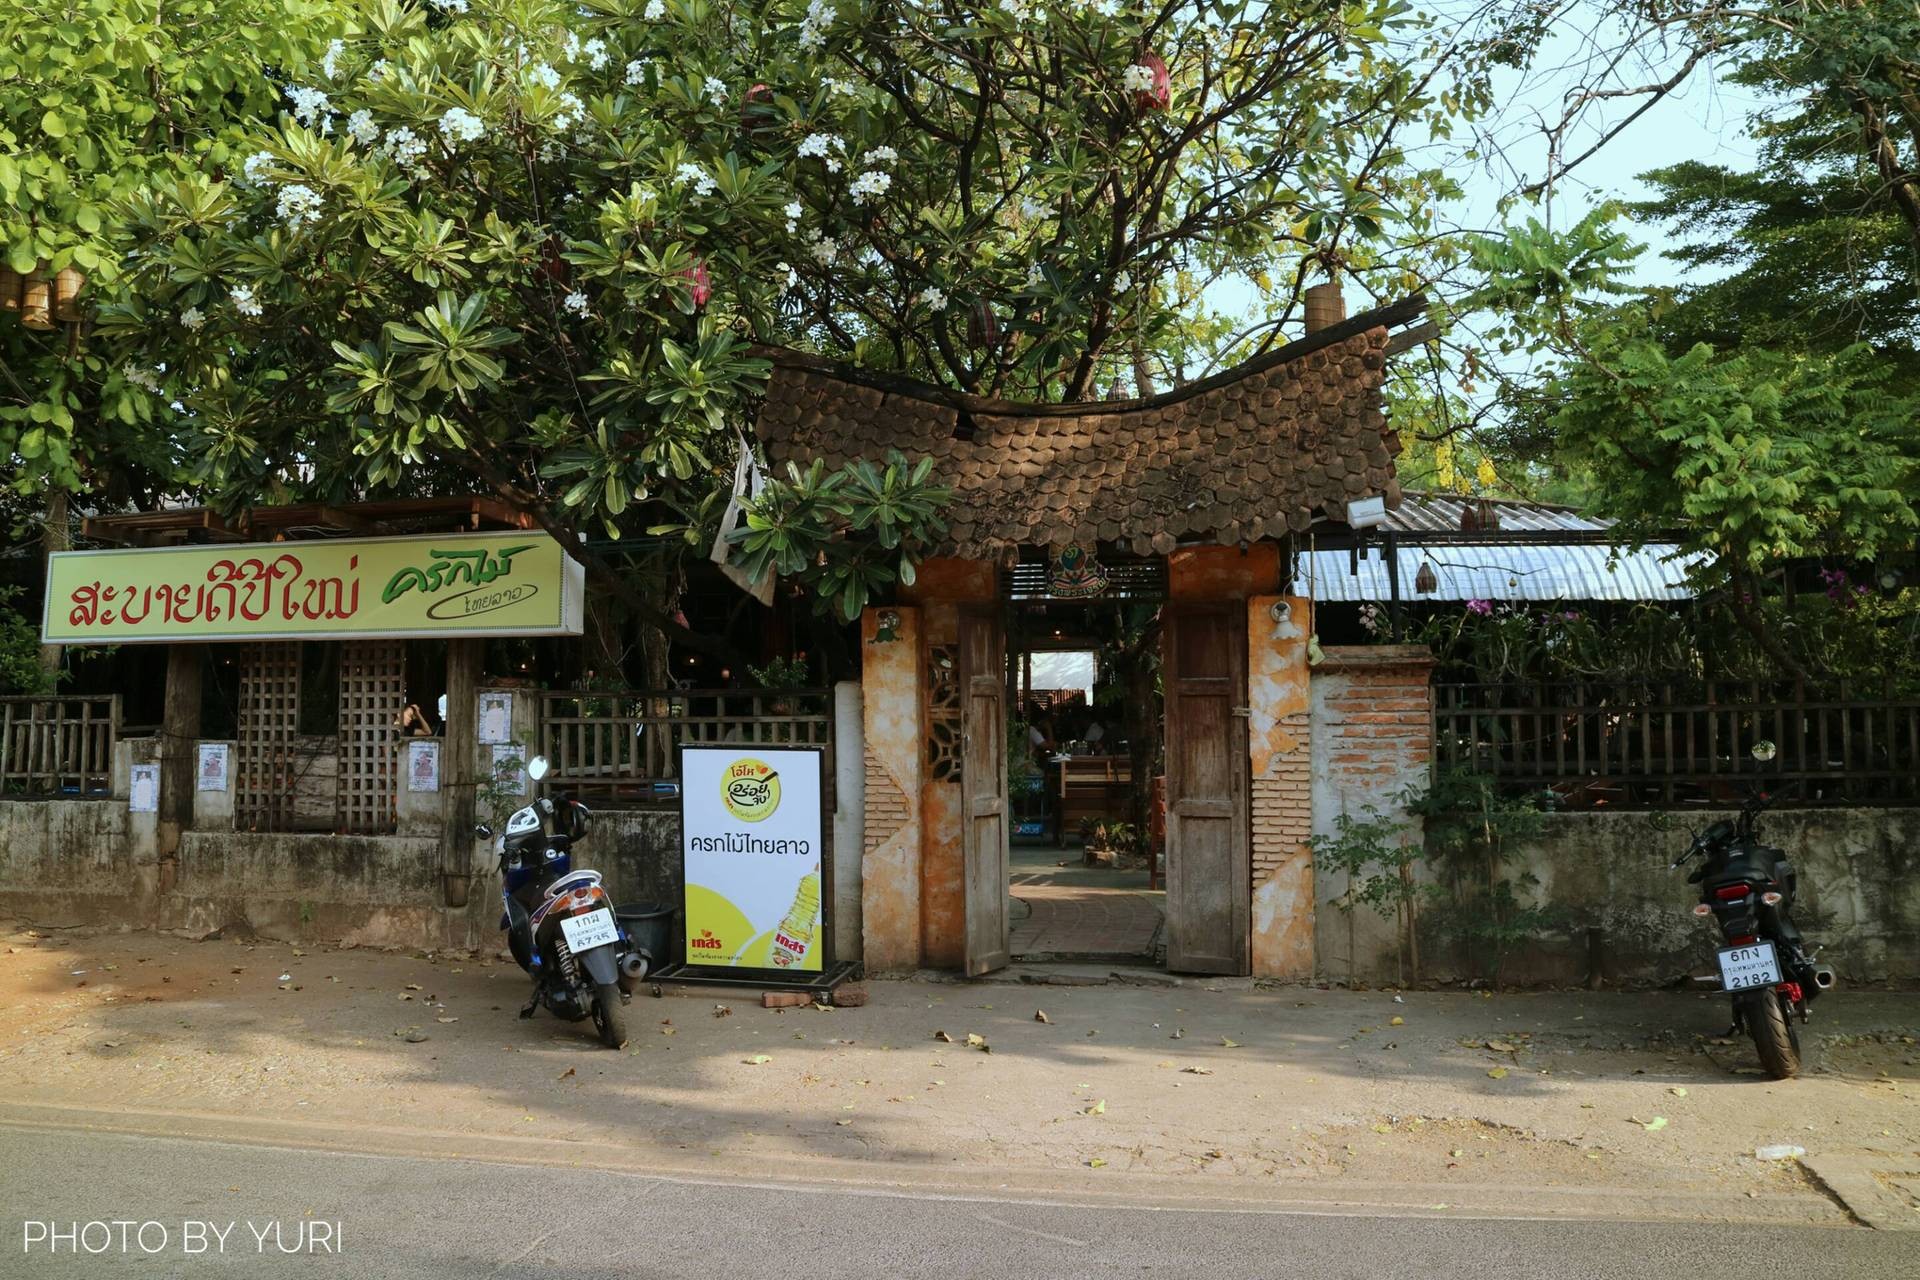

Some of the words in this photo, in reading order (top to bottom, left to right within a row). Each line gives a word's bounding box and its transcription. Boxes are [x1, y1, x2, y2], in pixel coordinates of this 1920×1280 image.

[730, 784, 768, 797] อร่อย
[690, 832, 810, 855] ครกไม้ไทยลาว
[691, 938, 722, 949] เกสร
[1730, 947, 1760, 962] 6กง
[1732, 971, 1771, 988] 2182
